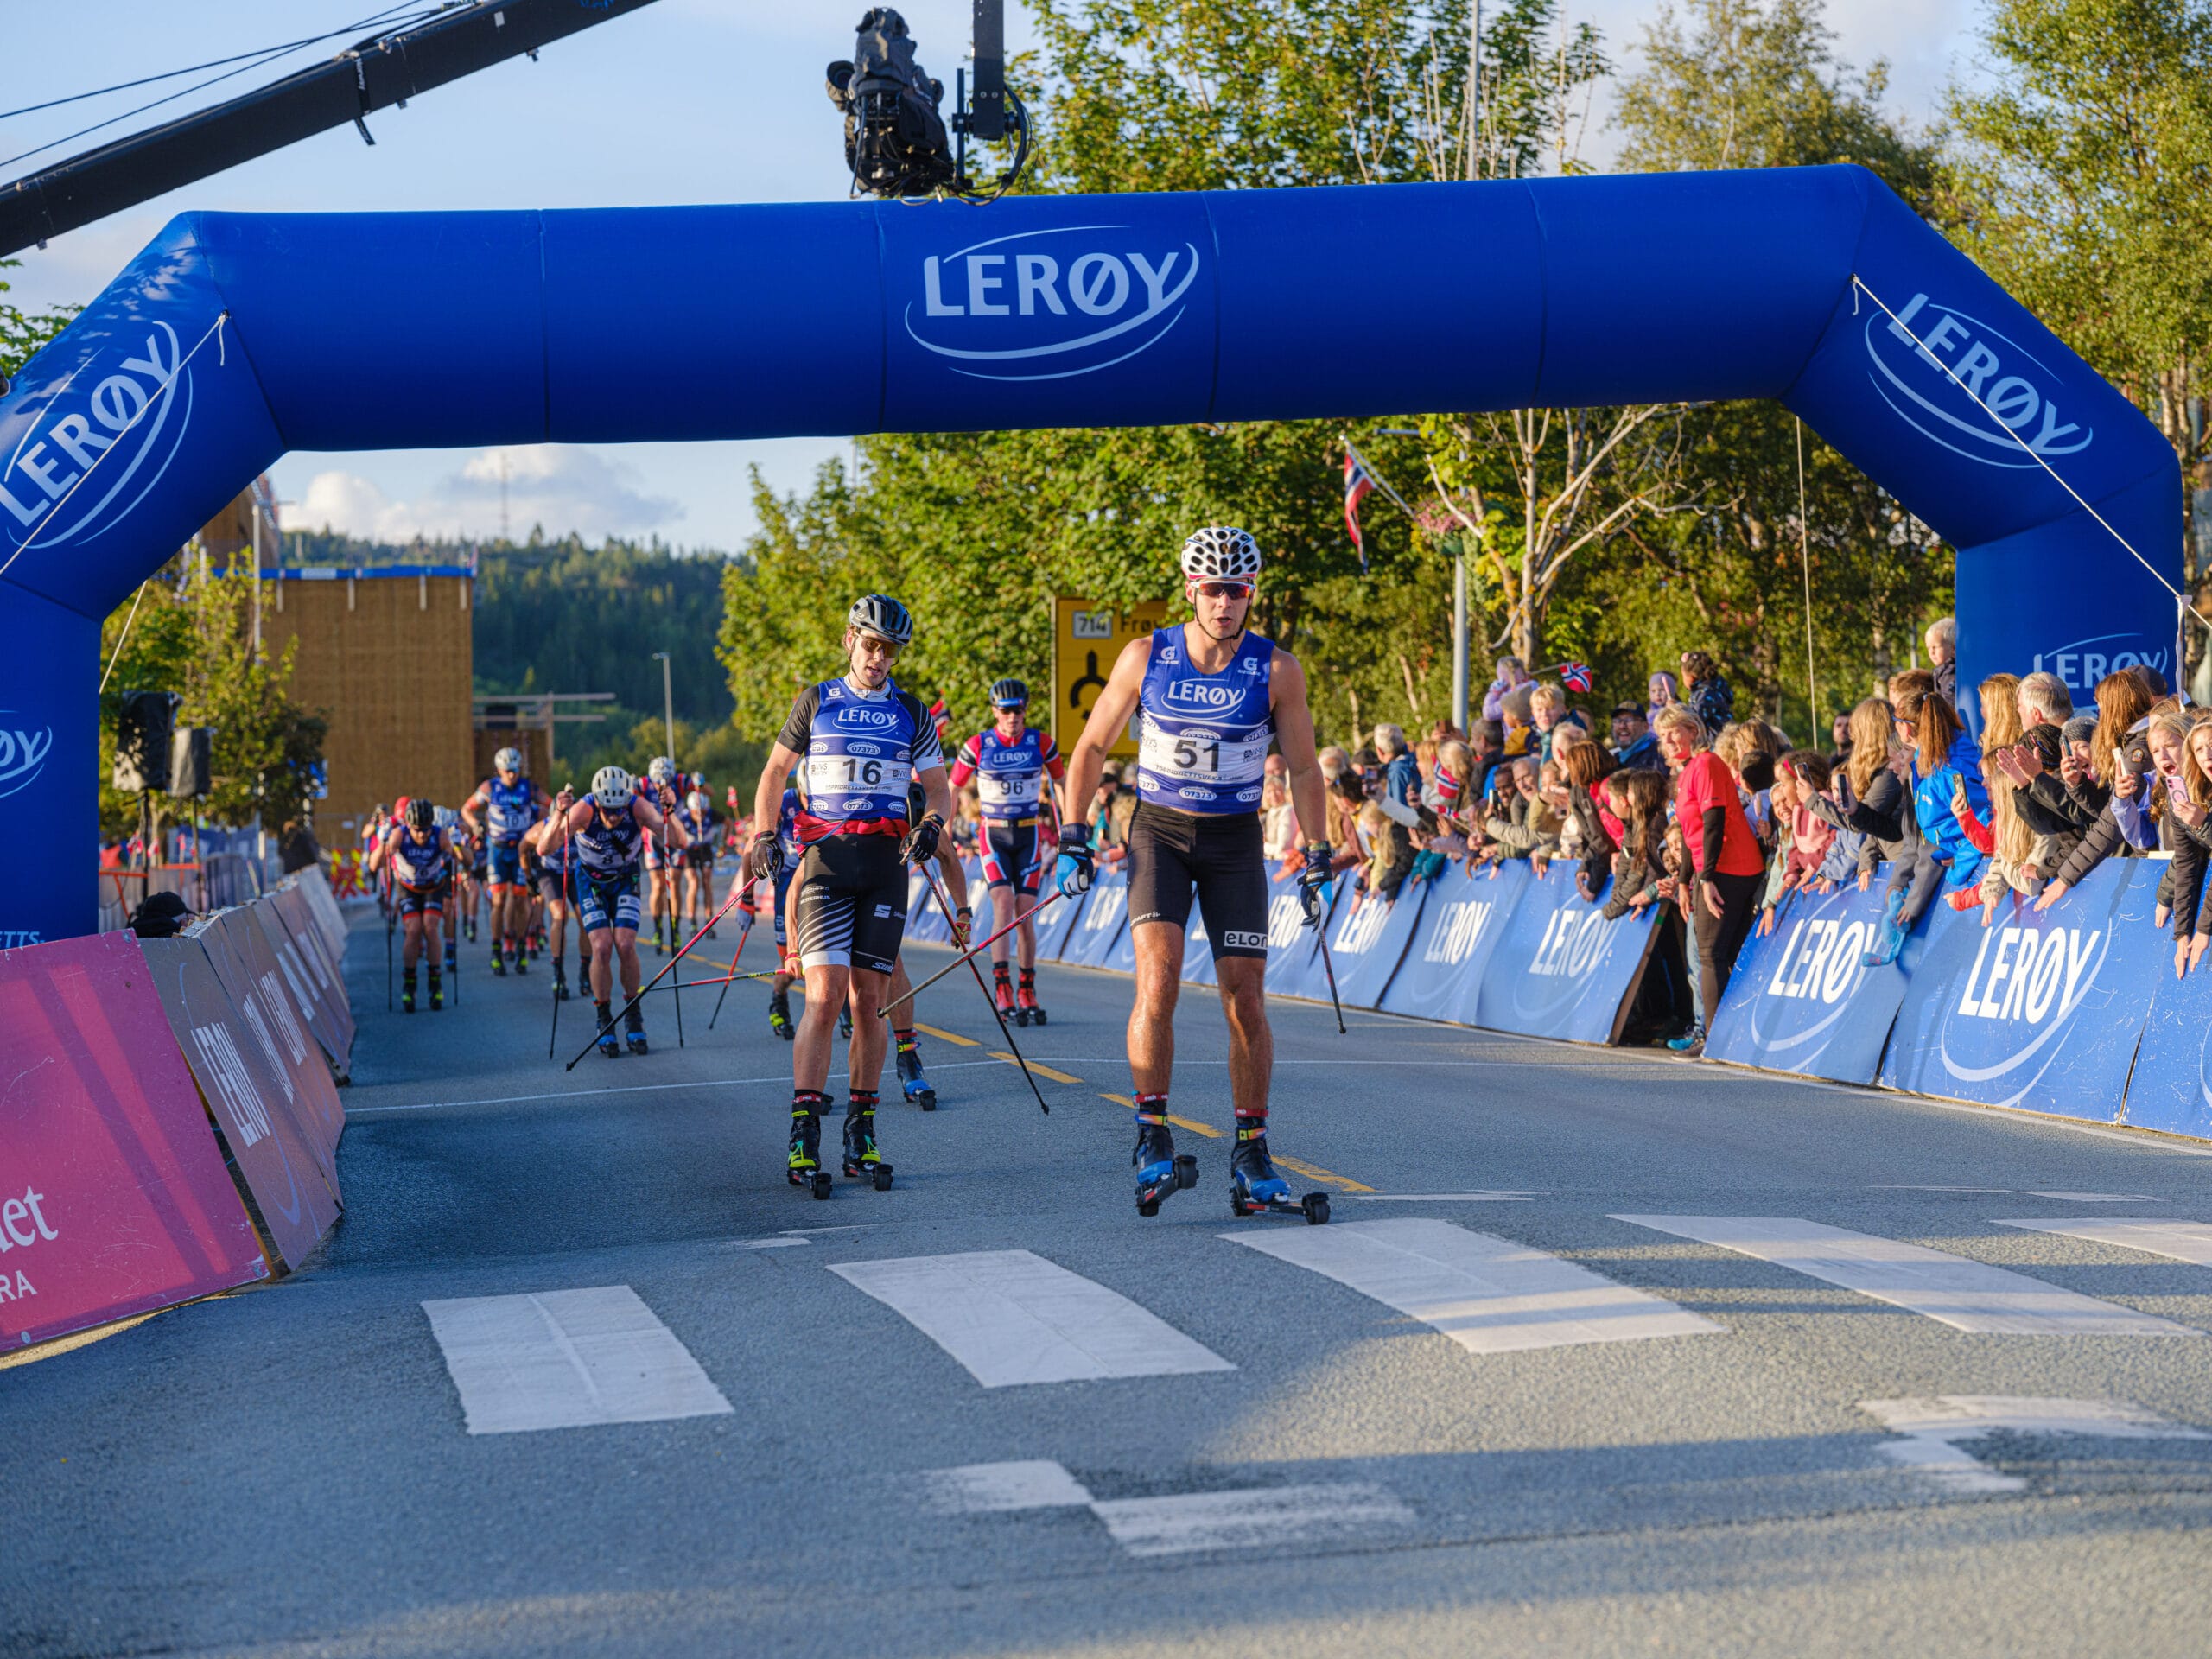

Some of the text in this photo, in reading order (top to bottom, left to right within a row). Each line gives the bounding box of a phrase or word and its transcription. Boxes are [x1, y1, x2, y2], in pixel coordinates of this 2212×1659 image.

[924, 252, 1179, 316] LERØY
[1886, 292, 2081, 453] LERØY
[0, 334, 173, 527] LERØY
[1079, 616, 1107, 632] 714
[1167, 681, 1241, 706] LERØY
[838, 709, 897, 726] LERØY
[1173, 740, 1219, 772] 51
[843, 758, 882, 785] 16
[1001, 780, 1024, 796] 96
[1185, 790, 1212, 799] 07373
[0, 931, 45, 949] TTS-
[1529, 909, 1614, 978] LERØY
[1957, 926, 2101, 1024] LERØY
